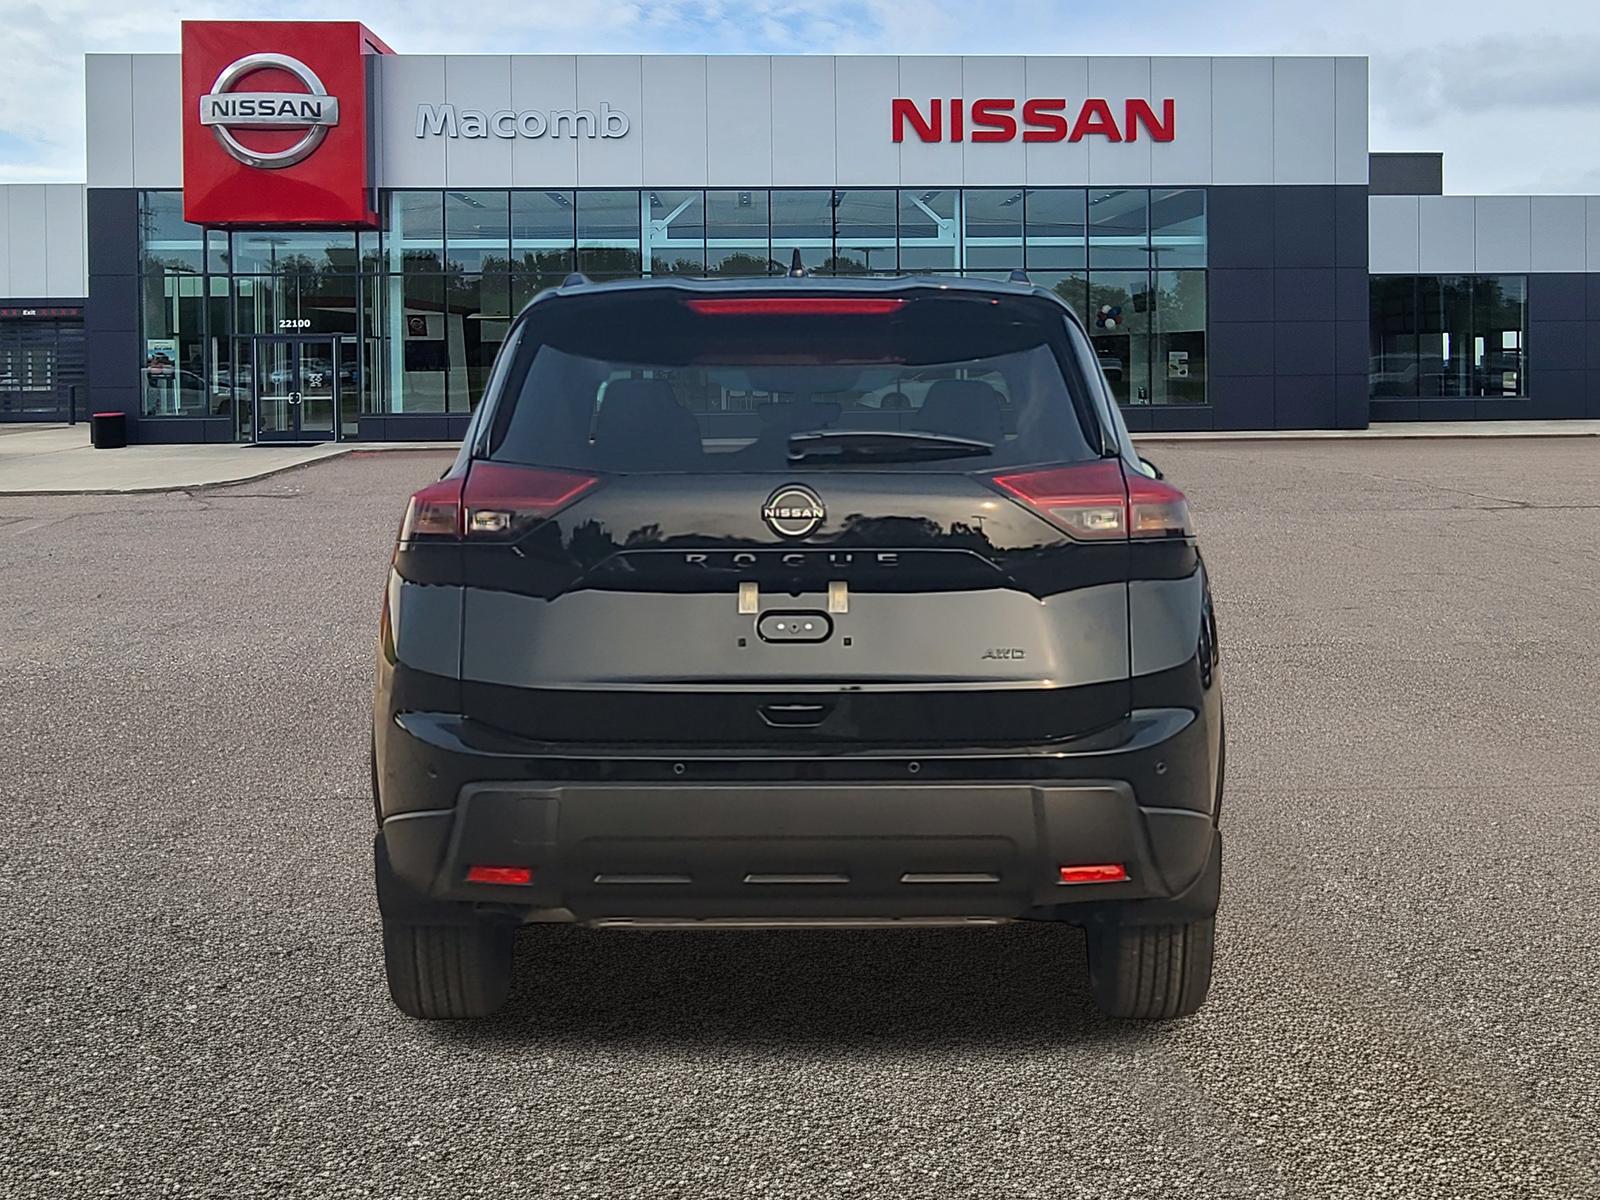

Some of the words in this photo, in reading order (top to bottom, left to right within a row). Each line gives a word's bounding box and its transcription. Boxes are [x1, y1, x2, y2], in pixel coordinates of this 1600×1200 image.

[211, 98, 322, 118] NISSAN
[415, 102, 631, 139] Macomb
[892, 98, 1175, 143] NISSAN
[279, 319, 311, 328] 22100
[764, 508, 824, 518] NISSAN
[685, 552, 900, 568] ROGUE
[981, 648, 1025, 660] AWD
